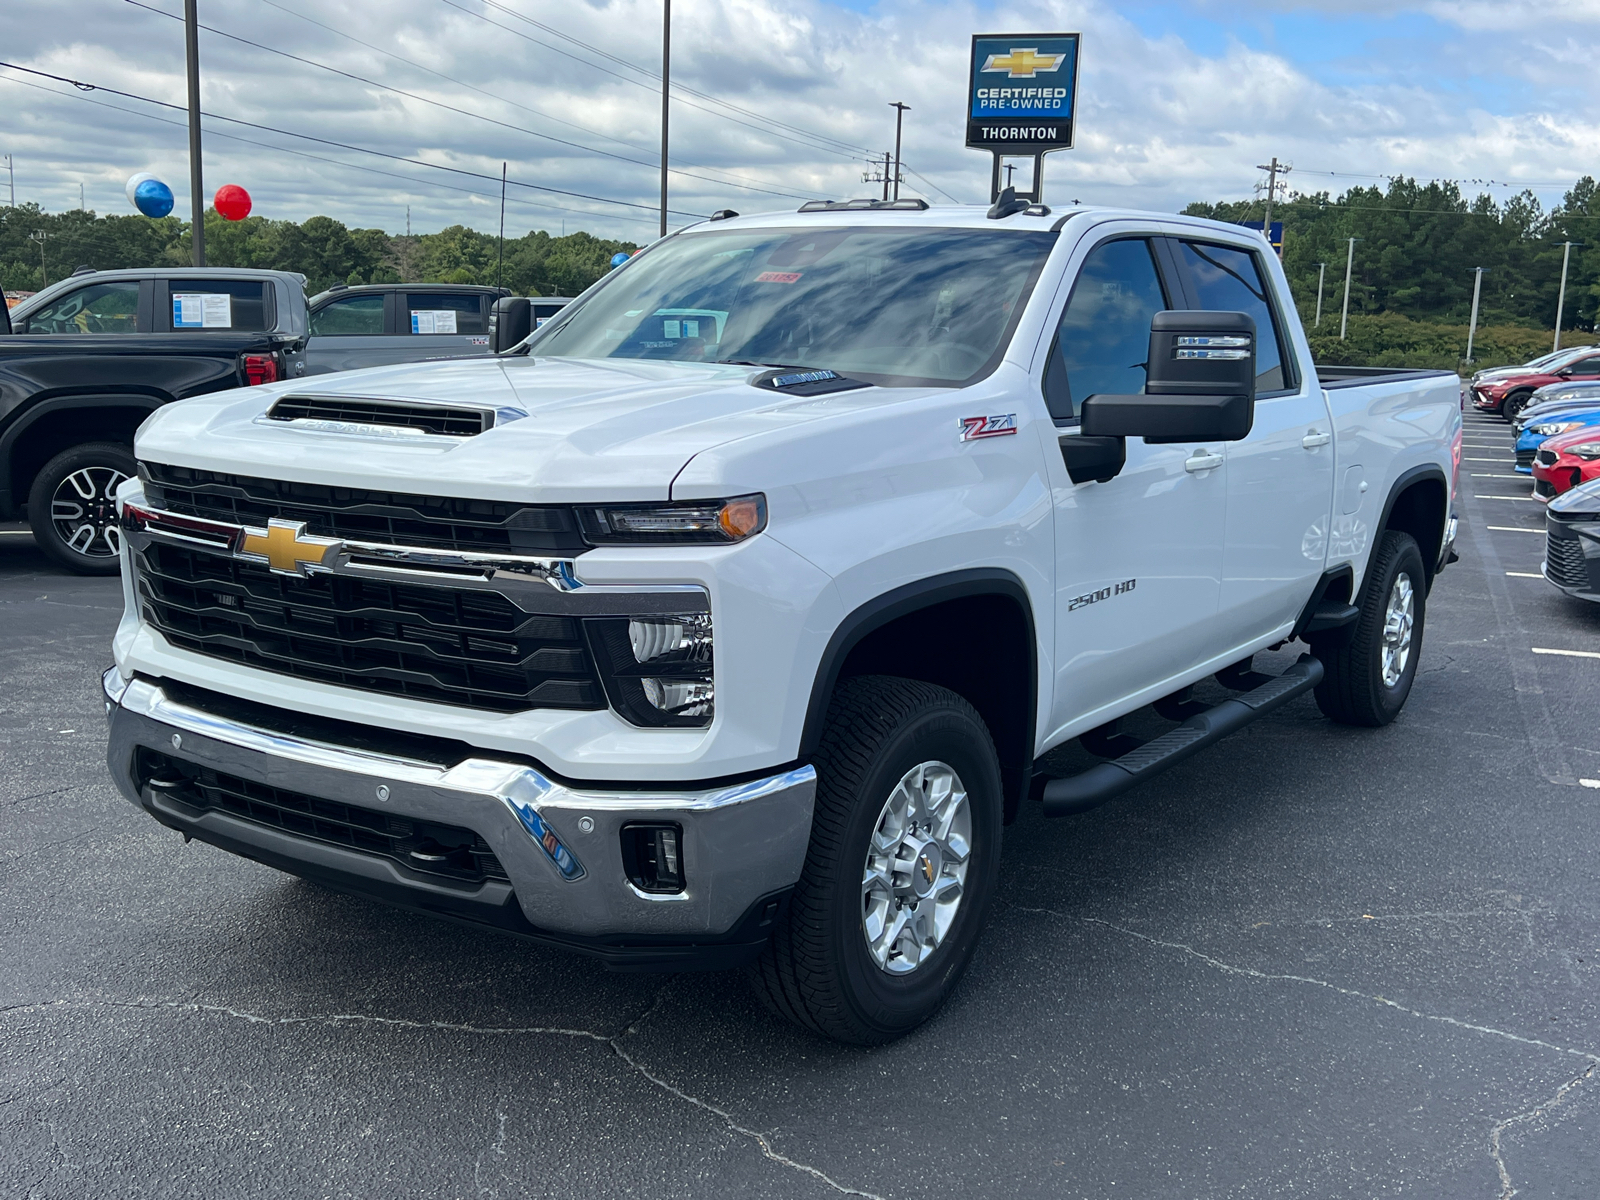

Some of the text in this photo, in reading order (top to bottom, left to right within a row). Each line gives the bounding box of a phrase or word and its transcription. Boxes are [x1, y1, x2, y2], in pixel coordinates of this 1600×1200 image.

[977, 87, 1067, 98] CERTIFIED
[980, 99, 1061, 109] PRE-OWNED
[981, 127, 1057, 139] THORNTON
[304, 420, 405, 436] CHEVROLET
[957, 413, 1018, 443] Z71
[1068, 579, 1136, 612] 2500 HD
